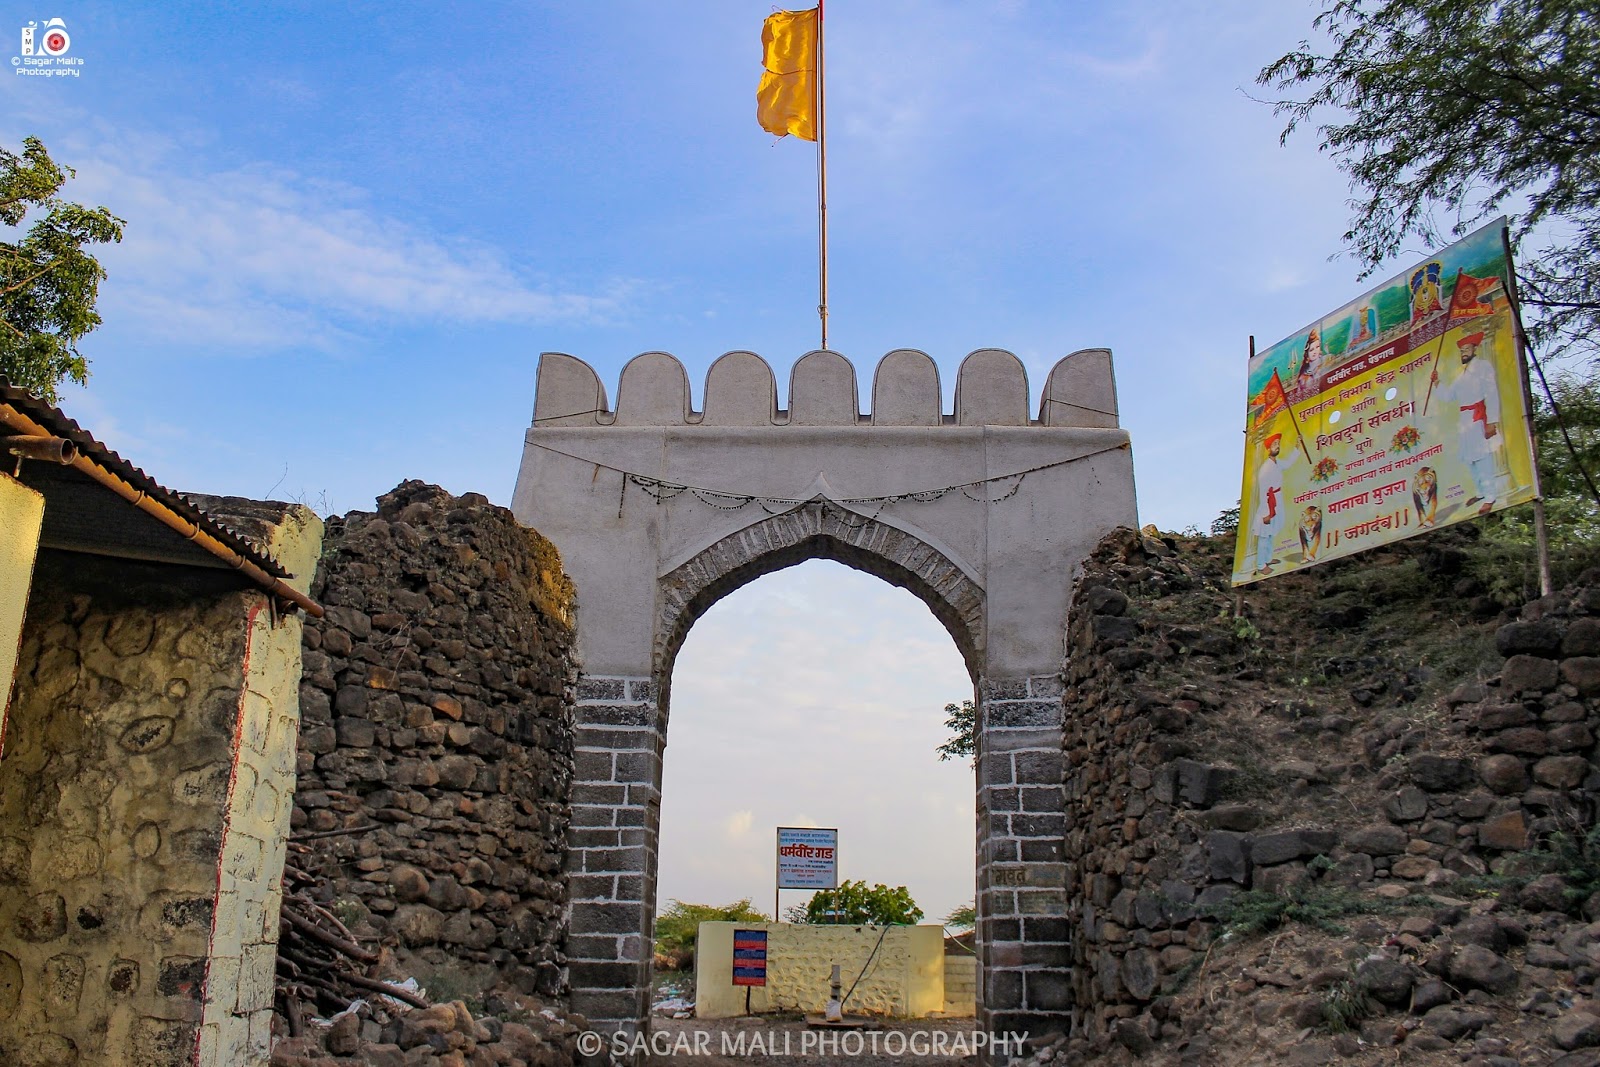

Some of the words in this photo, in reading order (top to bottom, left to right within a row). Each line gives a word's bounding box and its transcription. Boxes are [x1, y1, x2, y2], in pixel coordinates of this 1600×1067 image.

[1326, 366, 1351, 384] धर्मवीर
[1368, 346, 1395, 365] पेडगाव
[1299, 396, 1336, 423] पुरातत्व
[1339, 380, 1372, 402] विभाग
[1375, 370, 1395, 385] केंद्र
[1399, 352, 1432, 375] शासन
[1351, 396, 1376, 414] आणि
[1316, 420, 1364, 451] शिवदुर्ग
[1367, 400, 1416, 429] संवर्धन
[1355, 437, 1373, 455] पुणे
[1366, 449, 1386, 463] वतीने
[1293, 489, 1319, 504] धर्मवीर
[1320, 480, 1345, 496] गडावर
[1378, 460, 1393, 474] सर्व
[1327, 491, 1369, 514] मानाचा
[1372, 479, 1407, 505] मुजरा
[815, 847, 834, 859] गड
